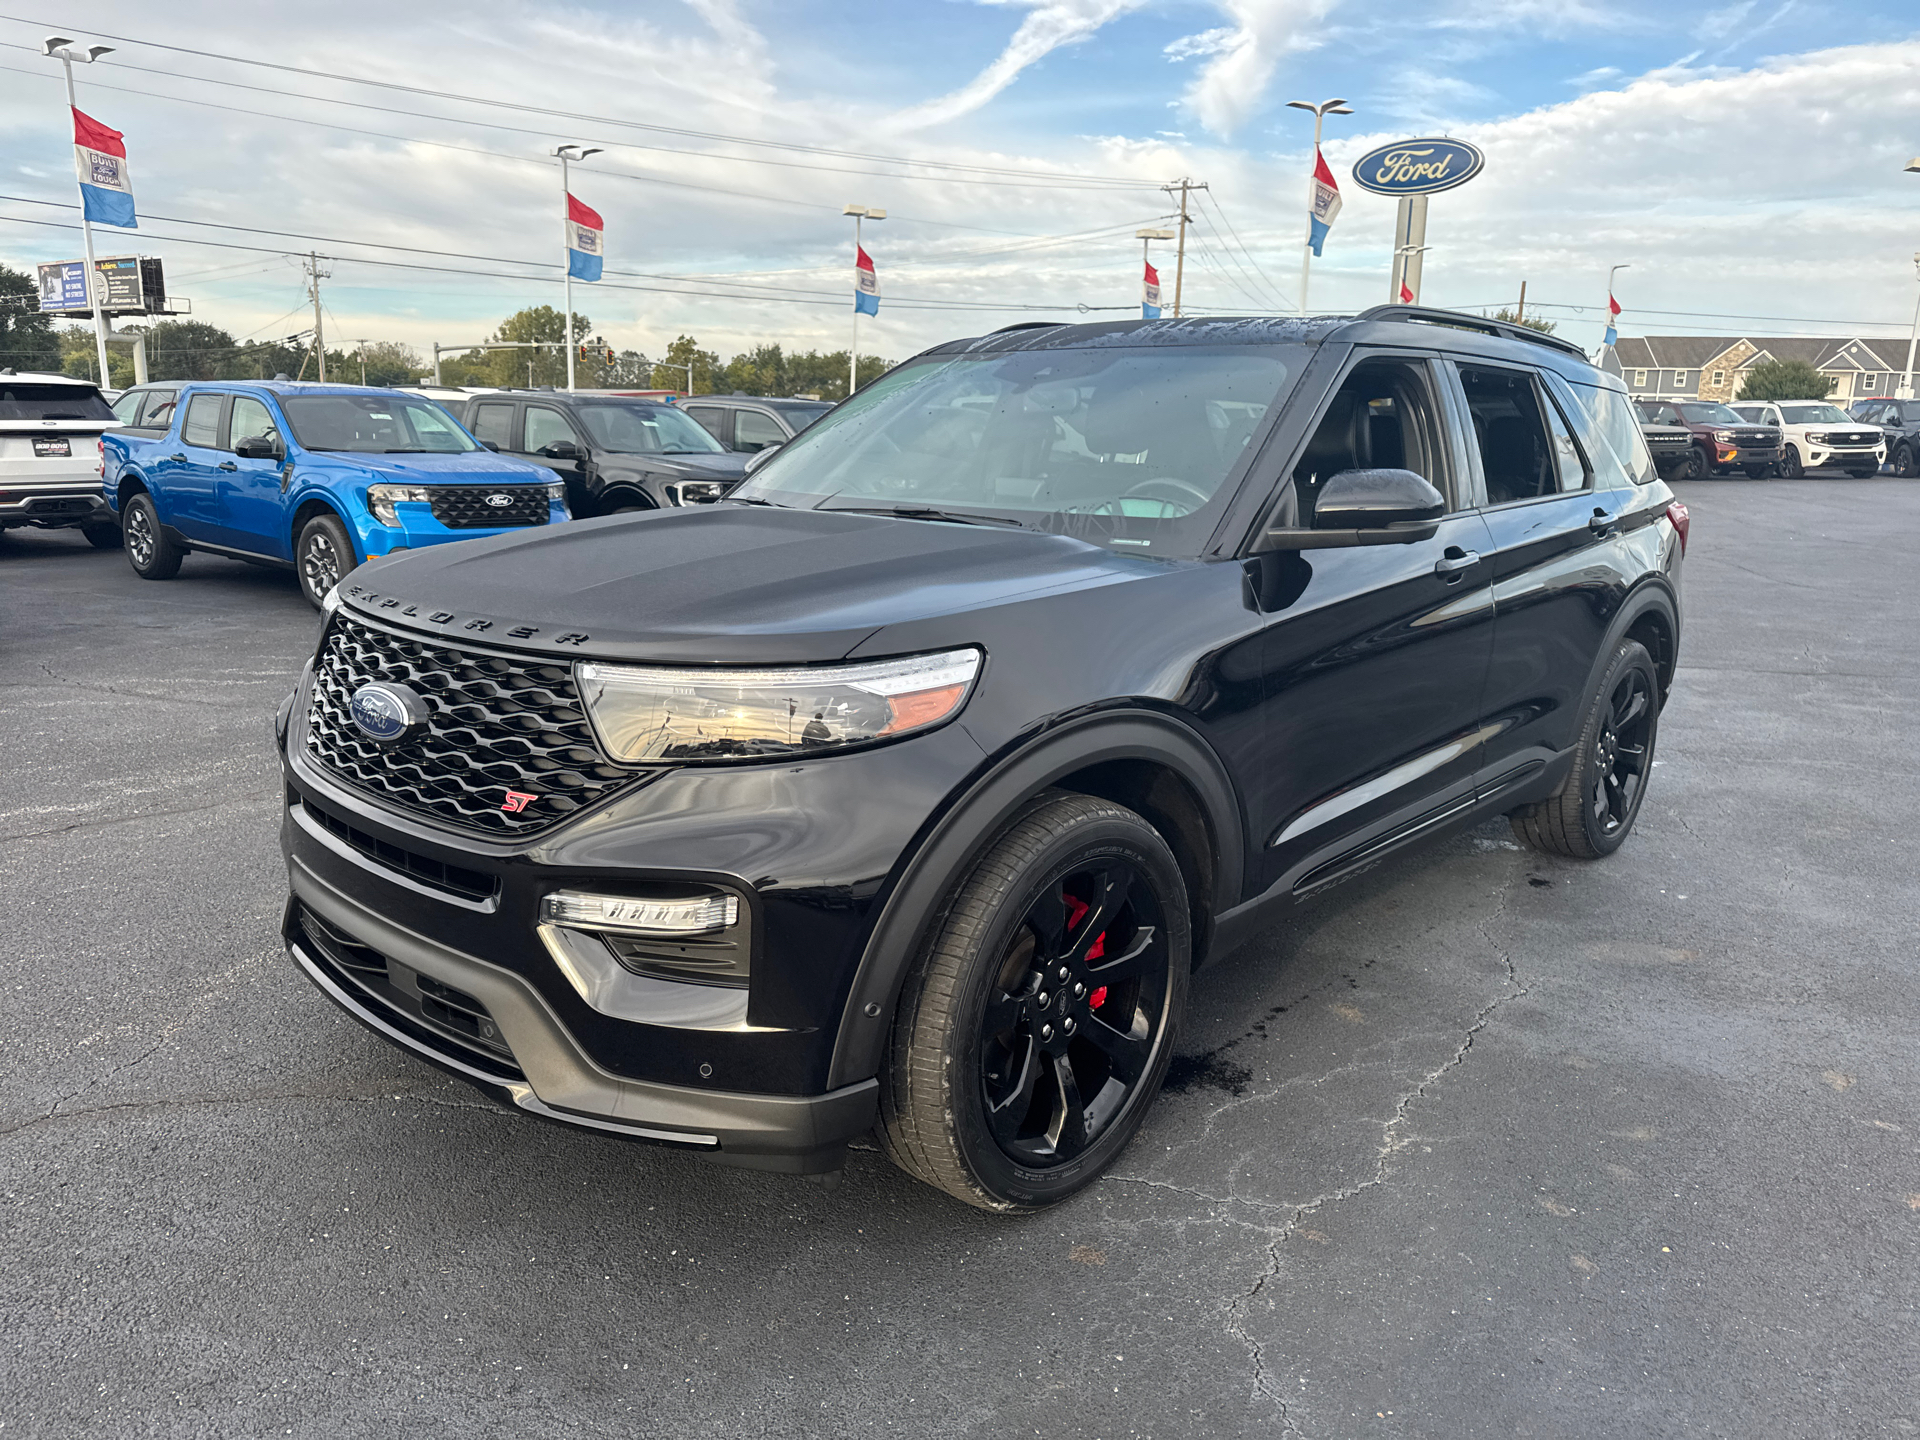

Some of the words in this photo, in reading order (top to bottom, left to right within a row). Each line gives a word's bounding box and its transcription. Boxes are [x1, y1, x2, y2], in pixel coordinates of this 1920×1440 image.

[91, 154, 117, 169] BUILT
[1376, 148, 1453, 184] Ford
[92, 173, 121, 186] TOUGH
[346, 584, 590, 646] EXPLORER
[356, 695, 391, 730] Ford
[500, 791, 539, 813] ST
